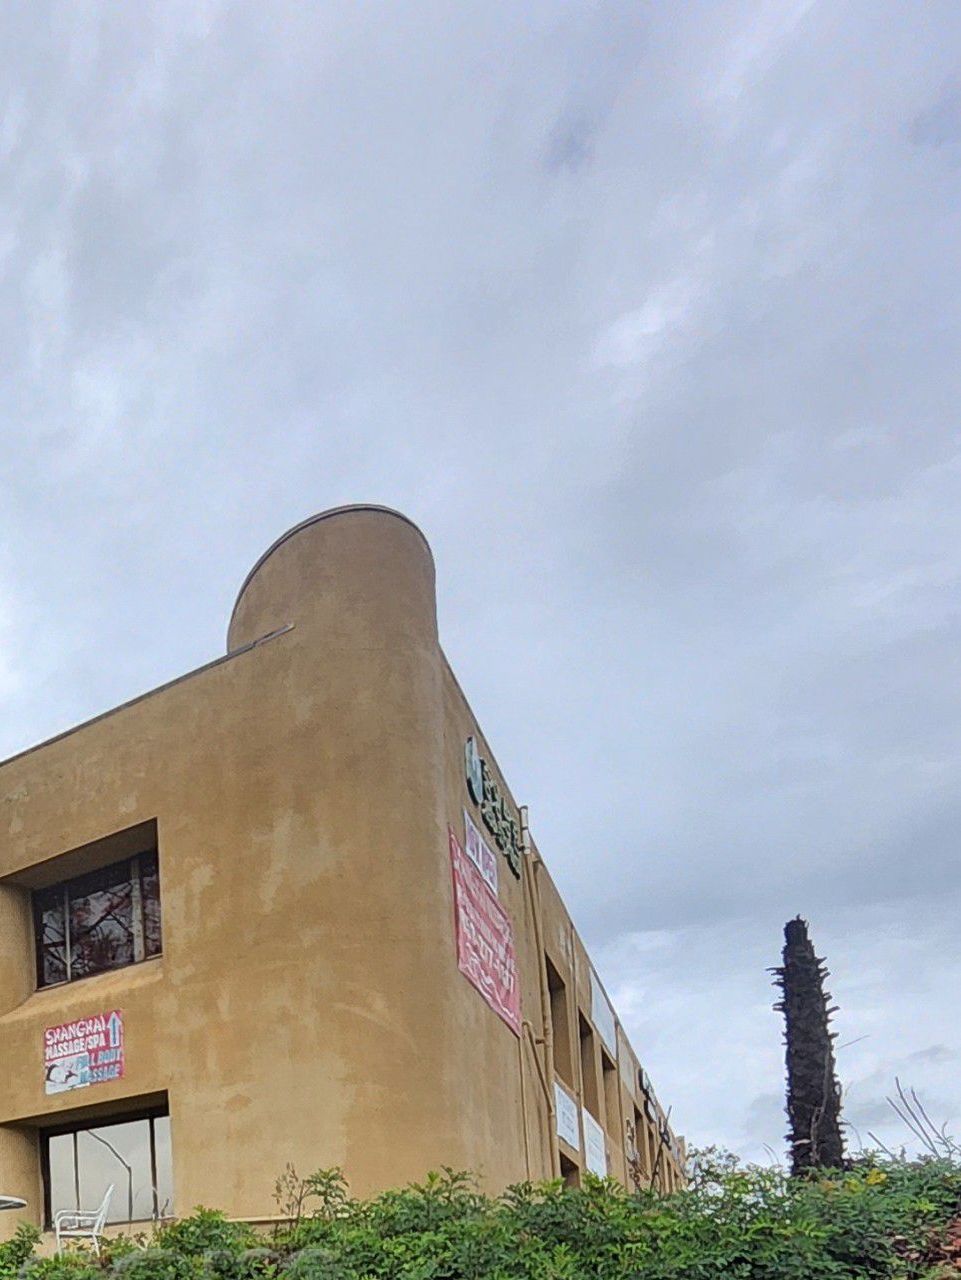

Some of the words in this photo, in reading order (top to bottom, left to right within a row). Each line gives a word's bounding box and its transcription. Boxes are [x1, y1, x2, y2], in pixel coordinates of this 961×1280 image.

[45, 1015, 106, 1046] SHANGHAI
[45, 1033, 106, 1060] MASSAGE/SPA
[98, 1048, 121, 1063] BODY
